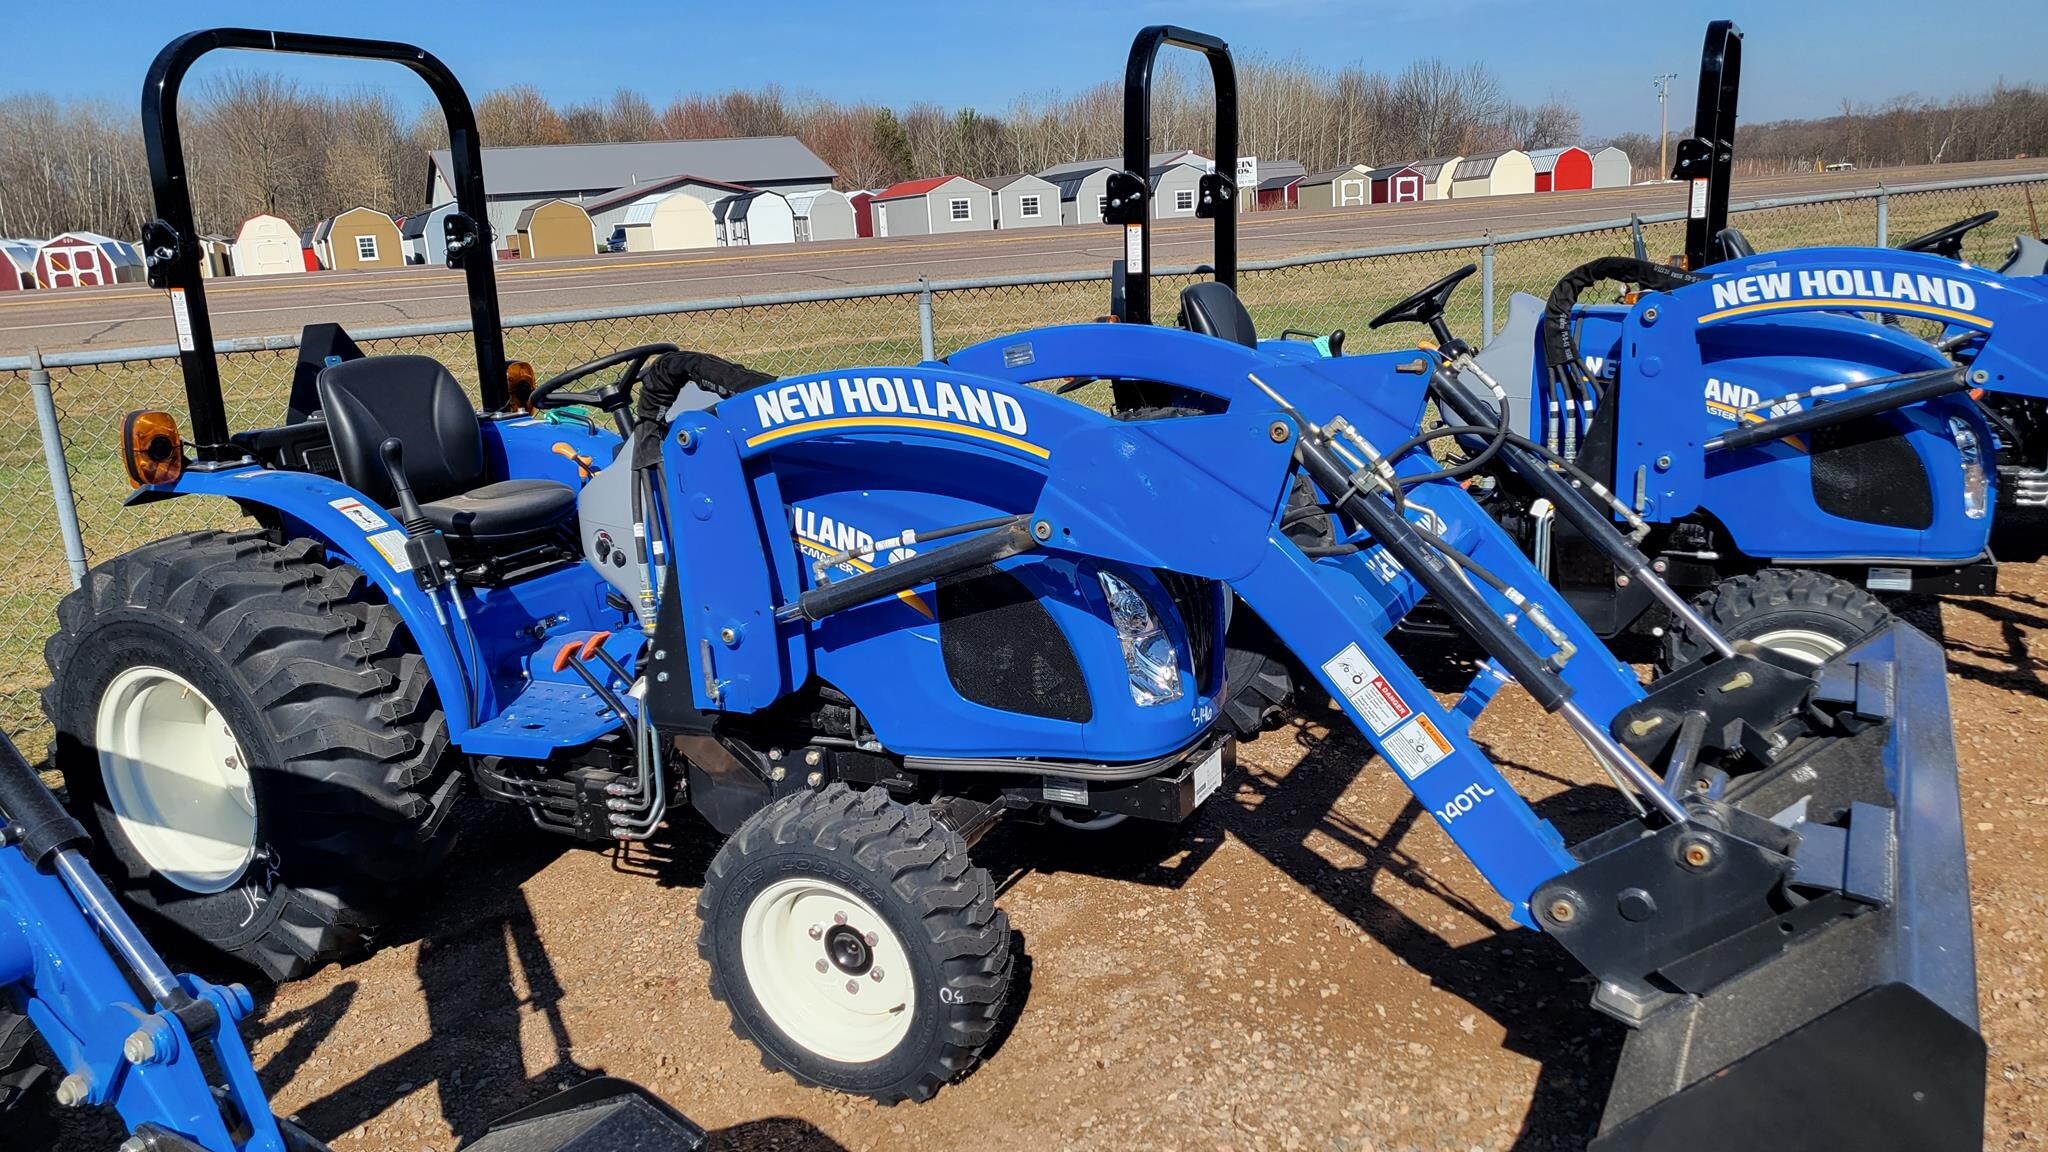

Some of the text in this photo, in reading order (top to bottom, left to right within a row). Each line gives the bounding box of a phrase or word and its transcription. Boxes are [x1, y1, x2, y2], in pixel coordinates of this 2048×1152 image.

[1711, 272, 1791, 309] NEW
[1798, 269, 1976, 311] HOLLAND
[753, 377, 1028, 436] NEW HOLLAND
[1381, 686, 1407, 716] DANGER
